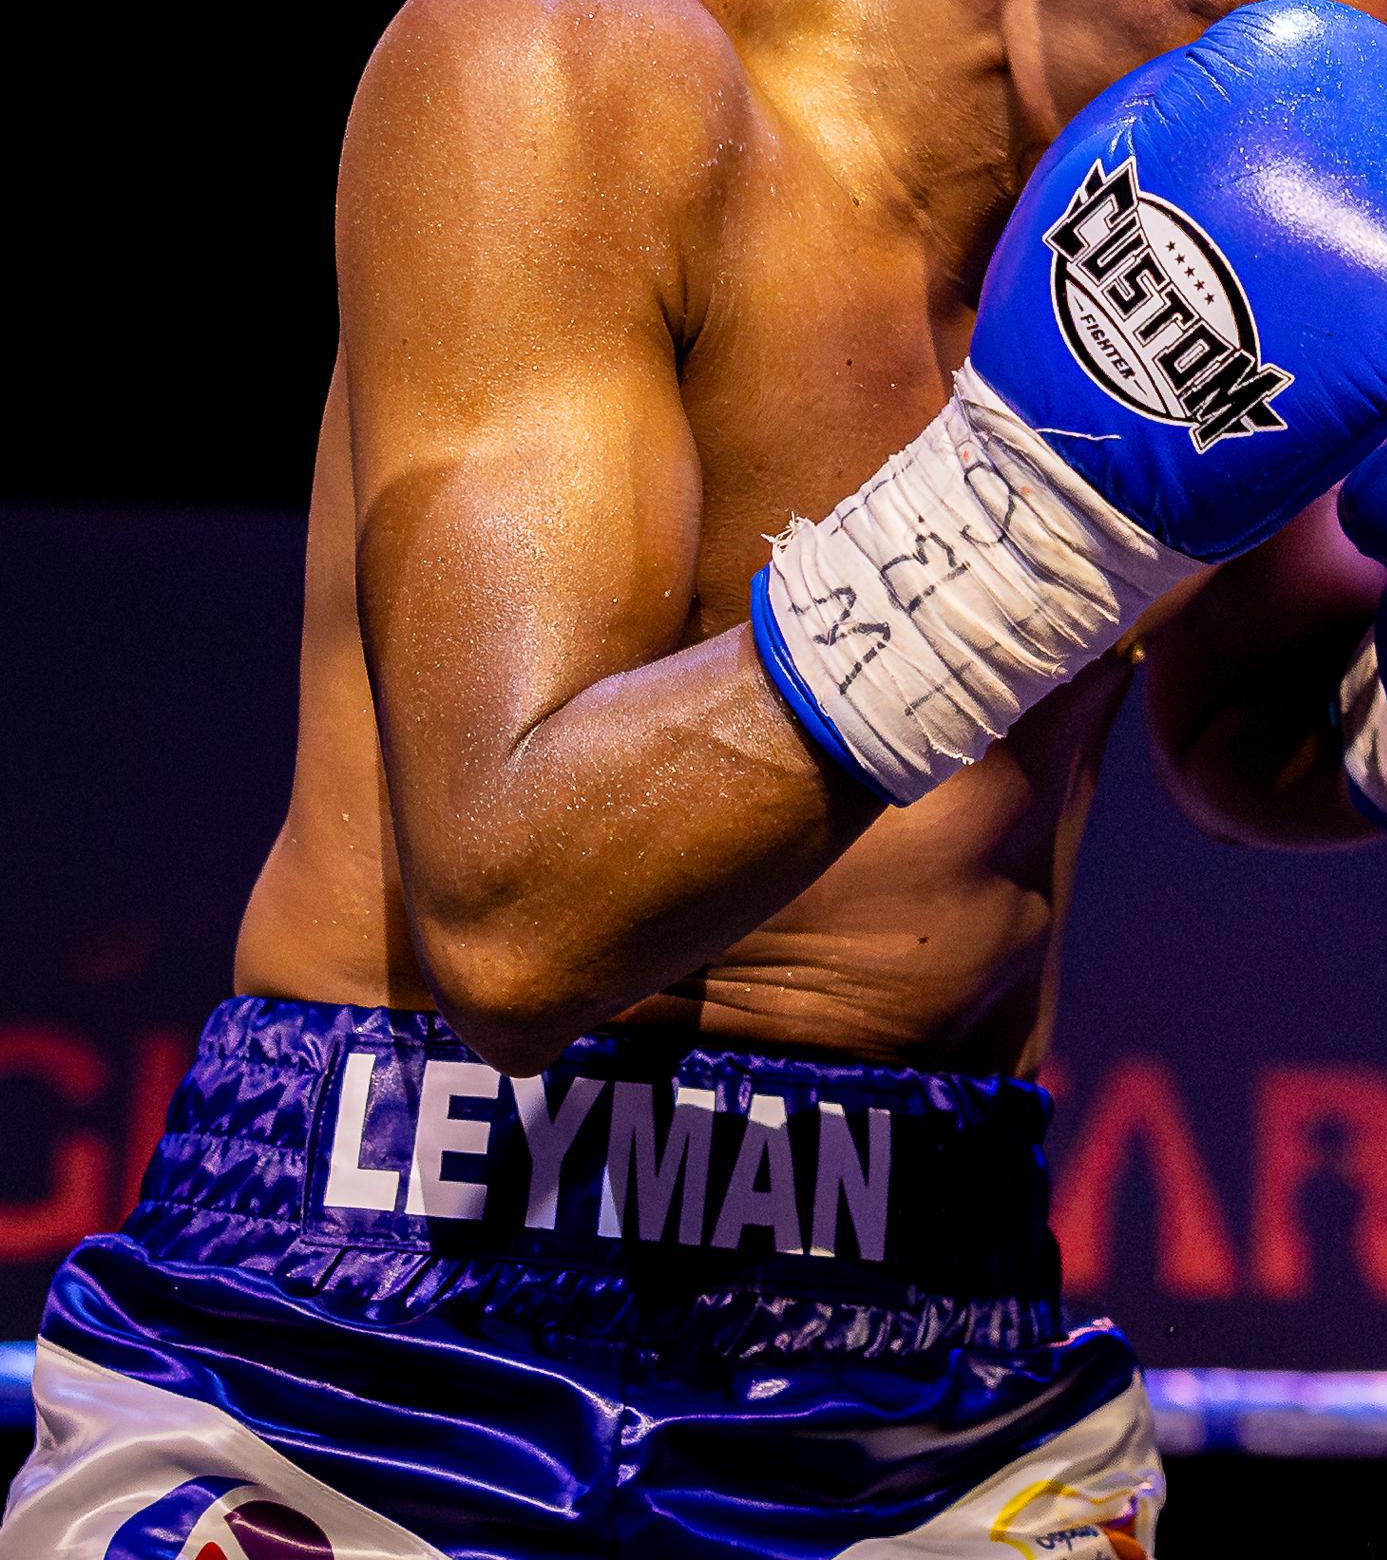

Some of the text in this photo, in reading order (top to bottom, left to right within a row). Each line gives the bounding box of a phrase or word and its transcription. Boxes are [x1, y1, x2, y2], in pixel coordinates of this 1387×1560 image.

[1043, 155, 1296, 454] CUSTOM
[1079, 312, 1137, 381] FIGHTER
[322, 1051, 892, 1263] LEYMAN
